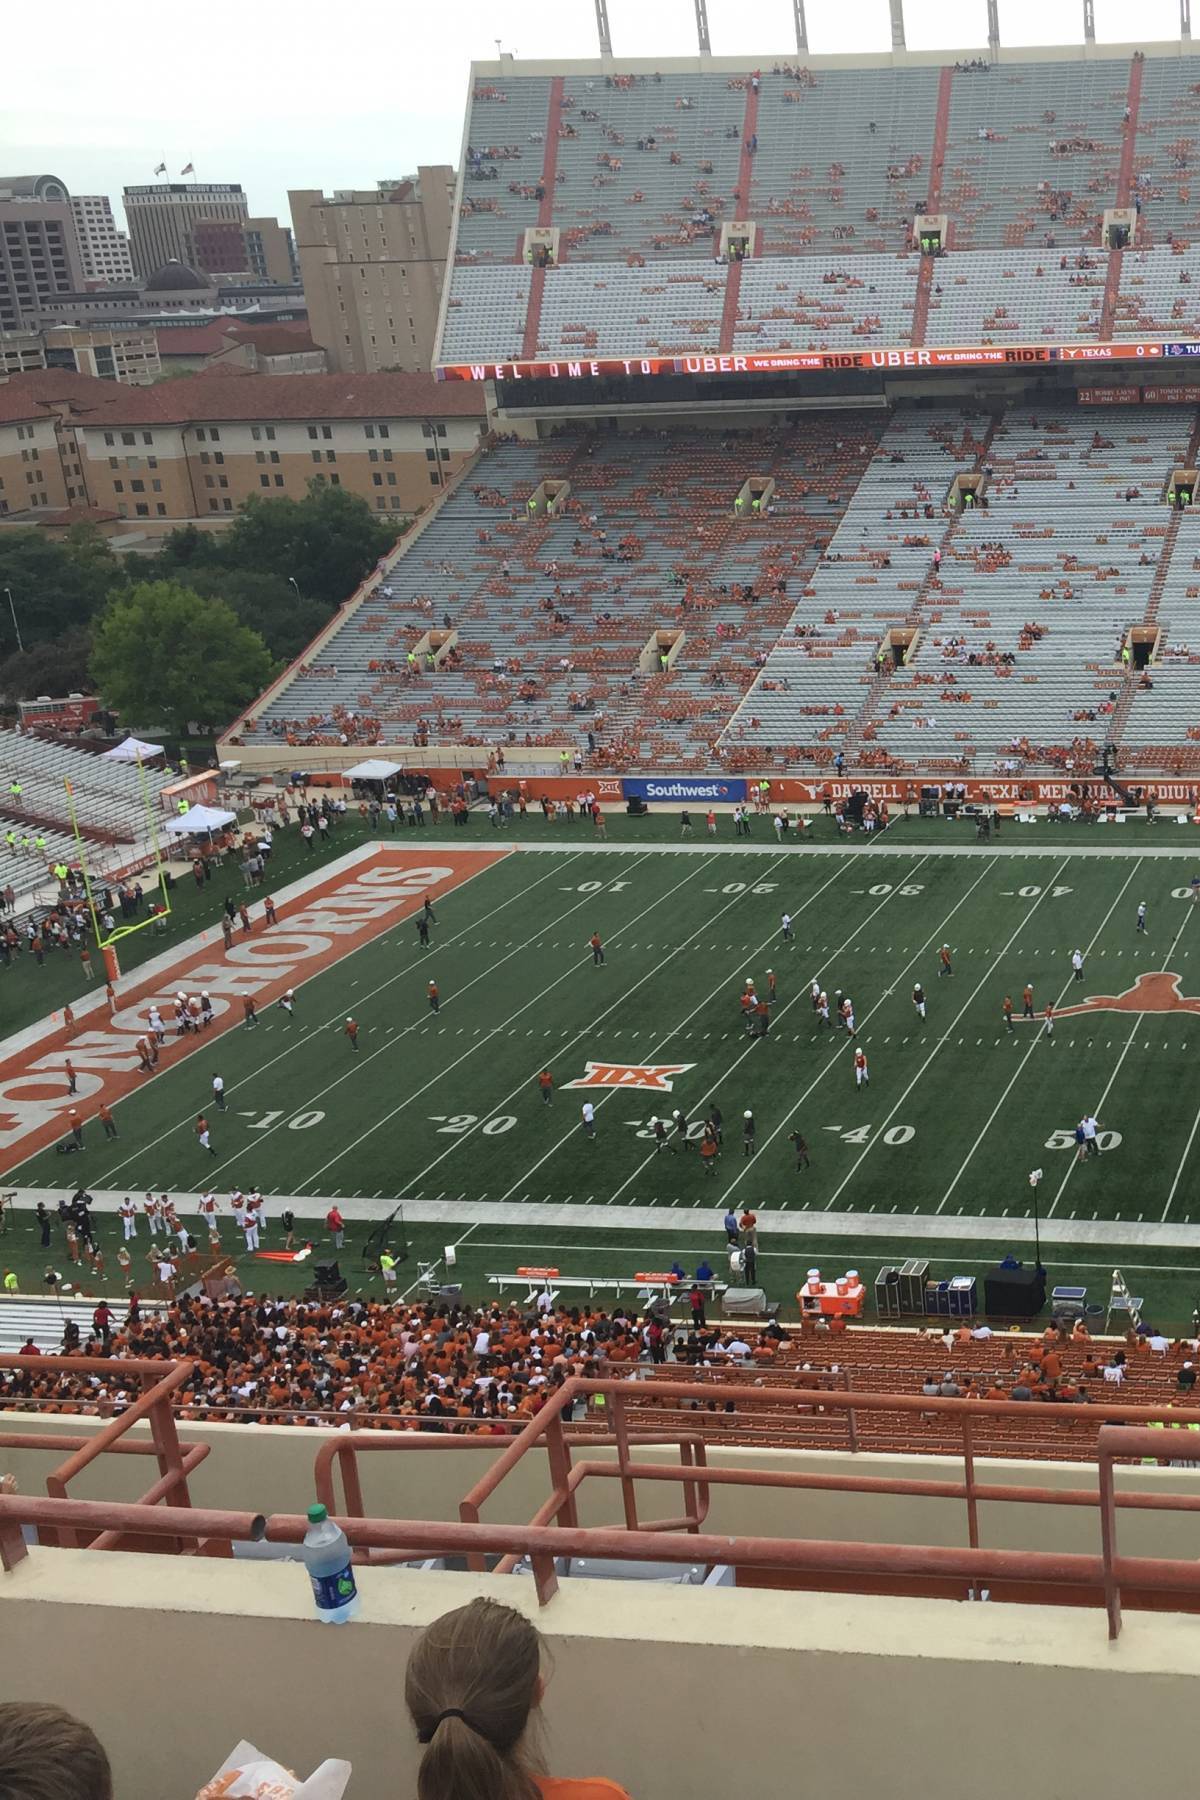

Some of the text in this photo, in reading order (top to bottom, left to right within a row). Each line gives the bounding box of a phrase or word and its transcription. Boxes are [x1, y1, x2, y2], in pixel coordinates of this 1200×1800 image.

[871, 350, 1046, 367] UBER WE BRING THE RIDE
[1081, 346, 1144, 357] TEXAS 0
[622, 360, 651, 375] TO
[687, 355, 863, 373] UBER WE BRING THE RIDE
[1079, 392, 1090, 401] 22
[1145, 391, 1156, 399] 60
[646, 782, 719, 796] Southwest
[577, 880, 632, 893] 10
[722, 882, 780, 895] 20
[868, 884, 926, 896] 30
[1018, 884, 1075, 897] 40
[246, 1110, 326, 1131] 10
[436, 1114, 519, 1135] 20
[838, 1125, 917, 1145] 40
[1045, 1129, 1123, 1151] 50
